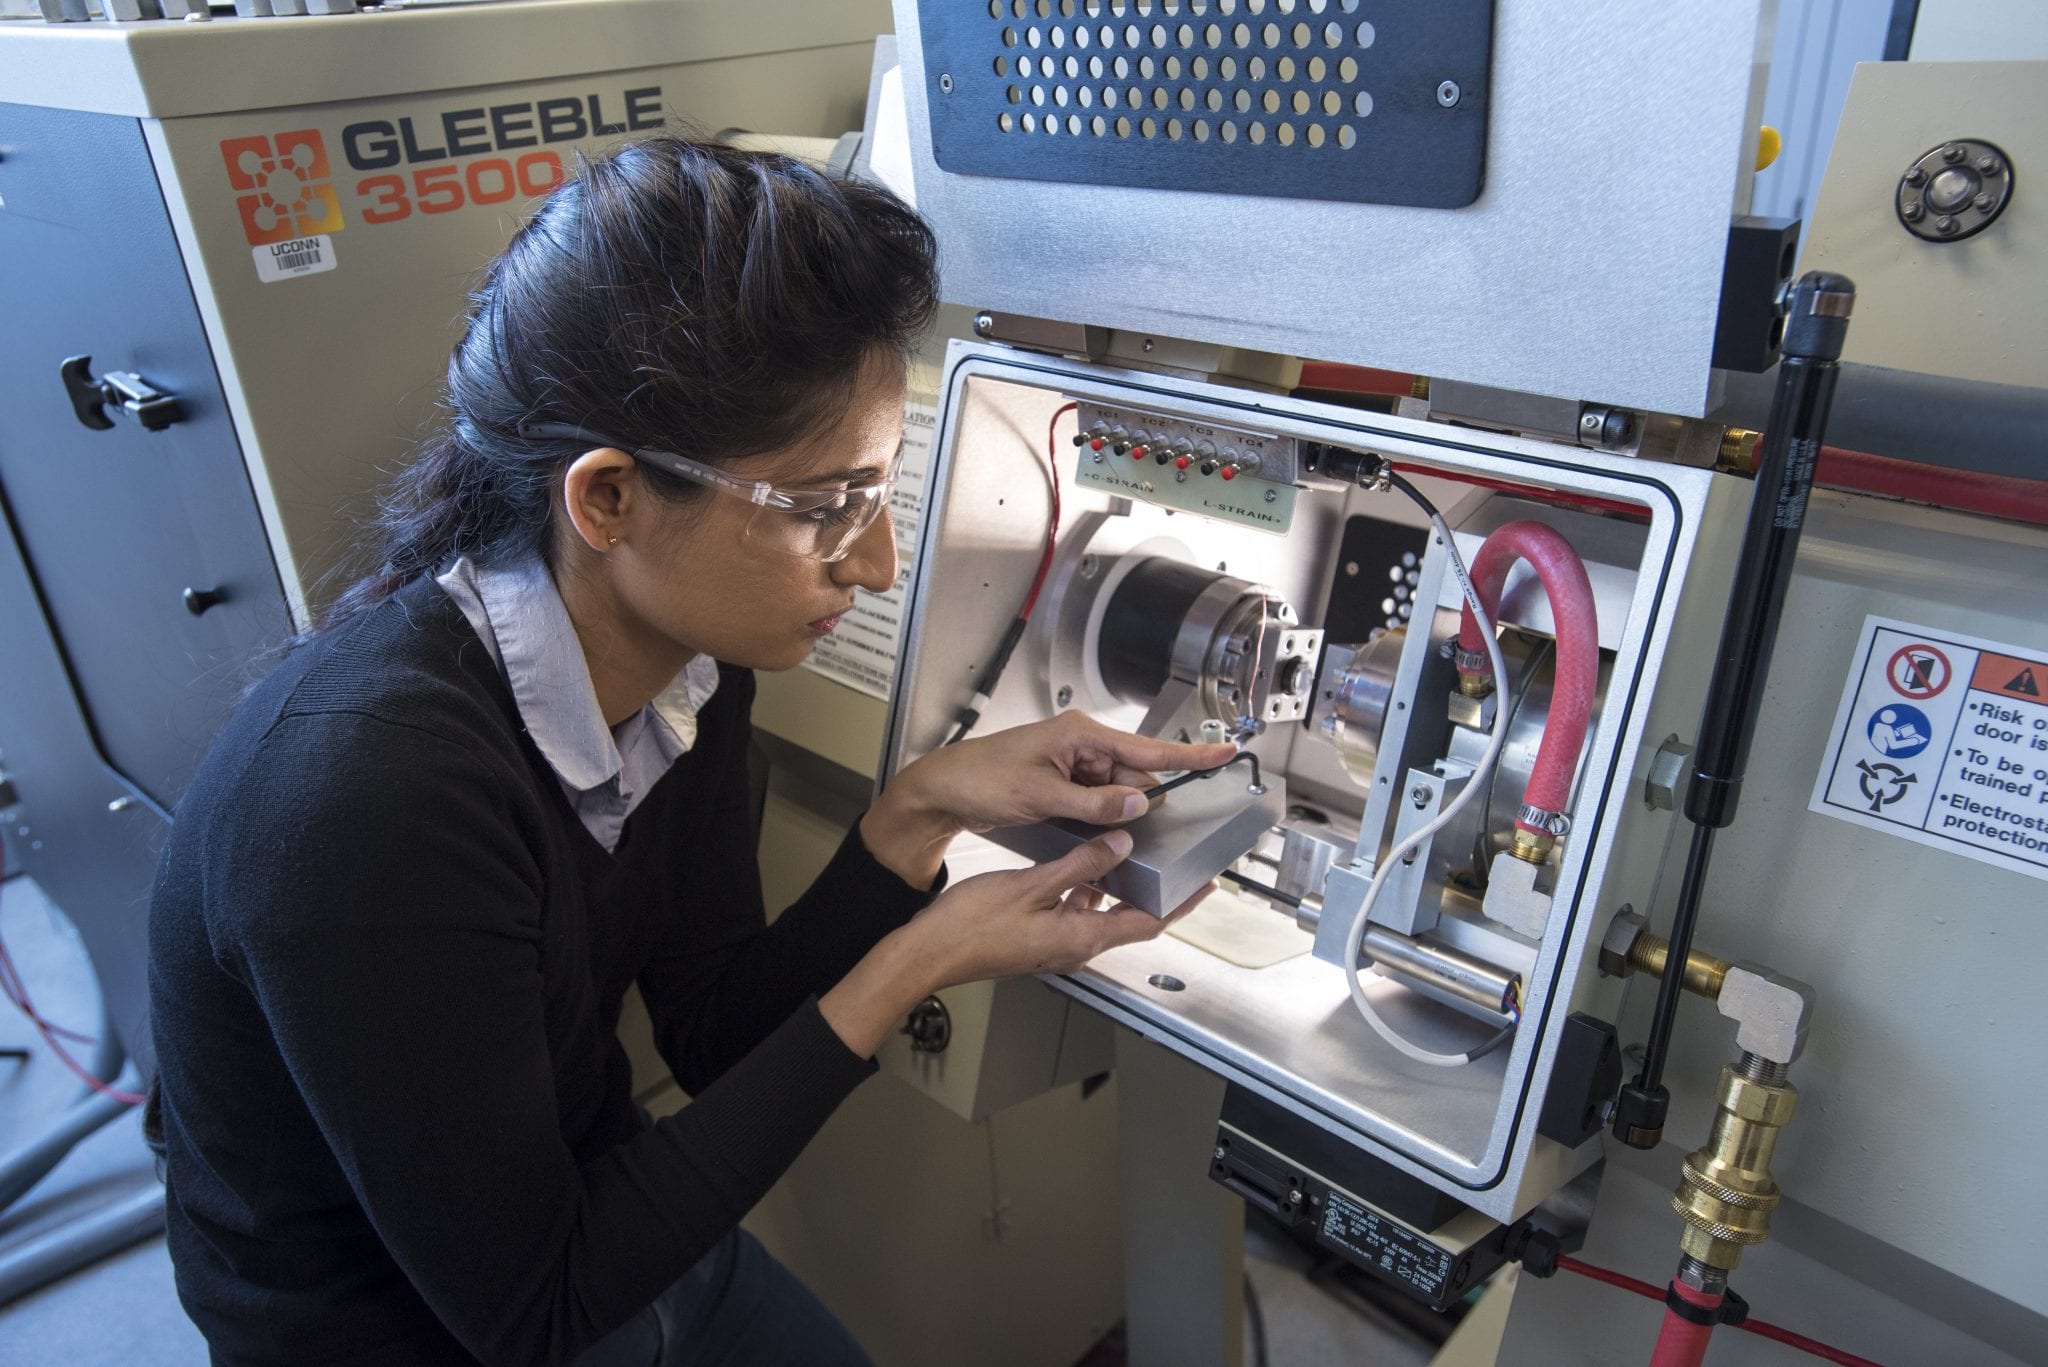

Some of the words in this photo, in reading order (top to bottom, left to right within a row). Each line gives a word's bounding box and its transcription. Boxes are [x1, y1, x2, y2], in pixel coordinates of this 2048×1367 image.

[341, 86, 666, 171] GLEEBLE
[356, 150, 565, 225] 3500
[270, 237, 320, 257] UCONN
[903, 409, 936, 424] LATION
[1097, 410, 1118, 418] TC1
[1142, 417, 1166, 426] TC2
[1188, 425, 1214, 436] TC3
[1238, 436, 1264, 448] TC4
[1092, 473, 1154, 493] C-STRAIN
[1203, 500, 1272, 522] L-STRAIN
[1978, 702, 2024, 725] Risk
[2033, 719, 2048, 731] o
[1974, 722, 2023, 744] door
[2030, 734, 2048, 751] is
[1967, 748, 1989, 766] To
[1997, 756, 2024, 775] be
[2033, 769, 2048, 786] o
[1960, 767, 2033, 797] trained
[1943, 814, 2048, 853] protection
